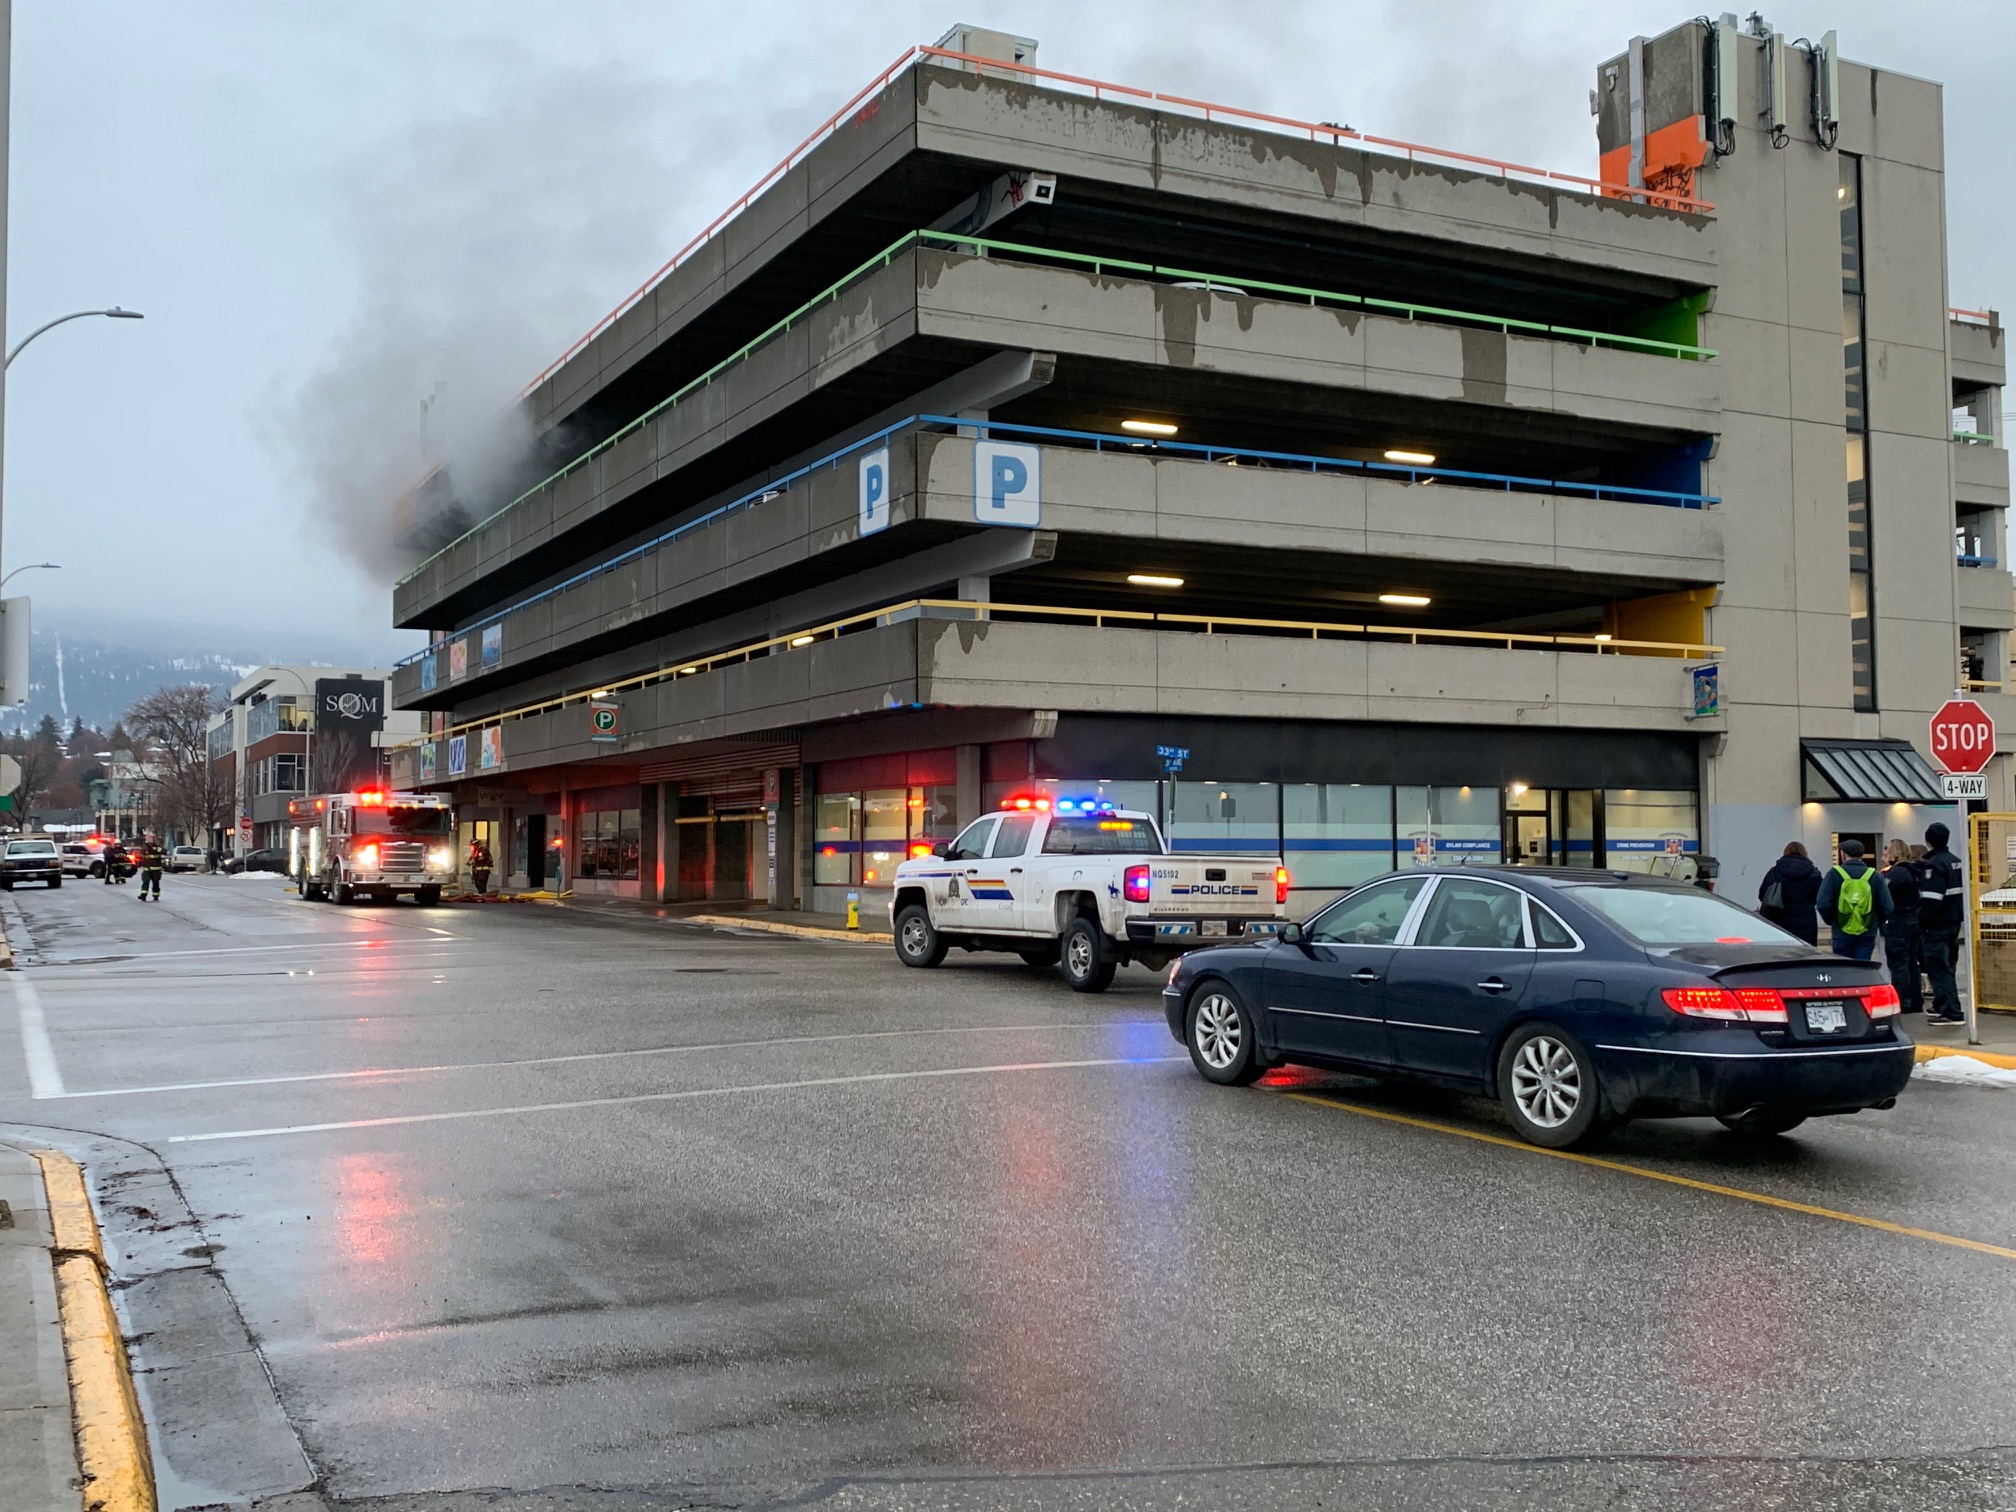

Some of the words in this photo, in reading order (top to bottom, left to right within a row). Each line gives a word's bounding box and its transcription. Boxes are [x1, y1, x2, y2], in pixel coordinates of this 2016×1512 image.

[992, 454, 1028, 509] P
[867, 464, 883, 520] P
[326, 692, 378, 719] SQM
[600, 712, 612, 728] P
[1936, 723, 1989, 750] STOP
[1177, 749, 1188, 758] ST
[1947, 779, 1983, 794] 4-WAY
[1152, 869, 1179, 879] NQ5102
[1190, 885, 1240, 895] POLICE
